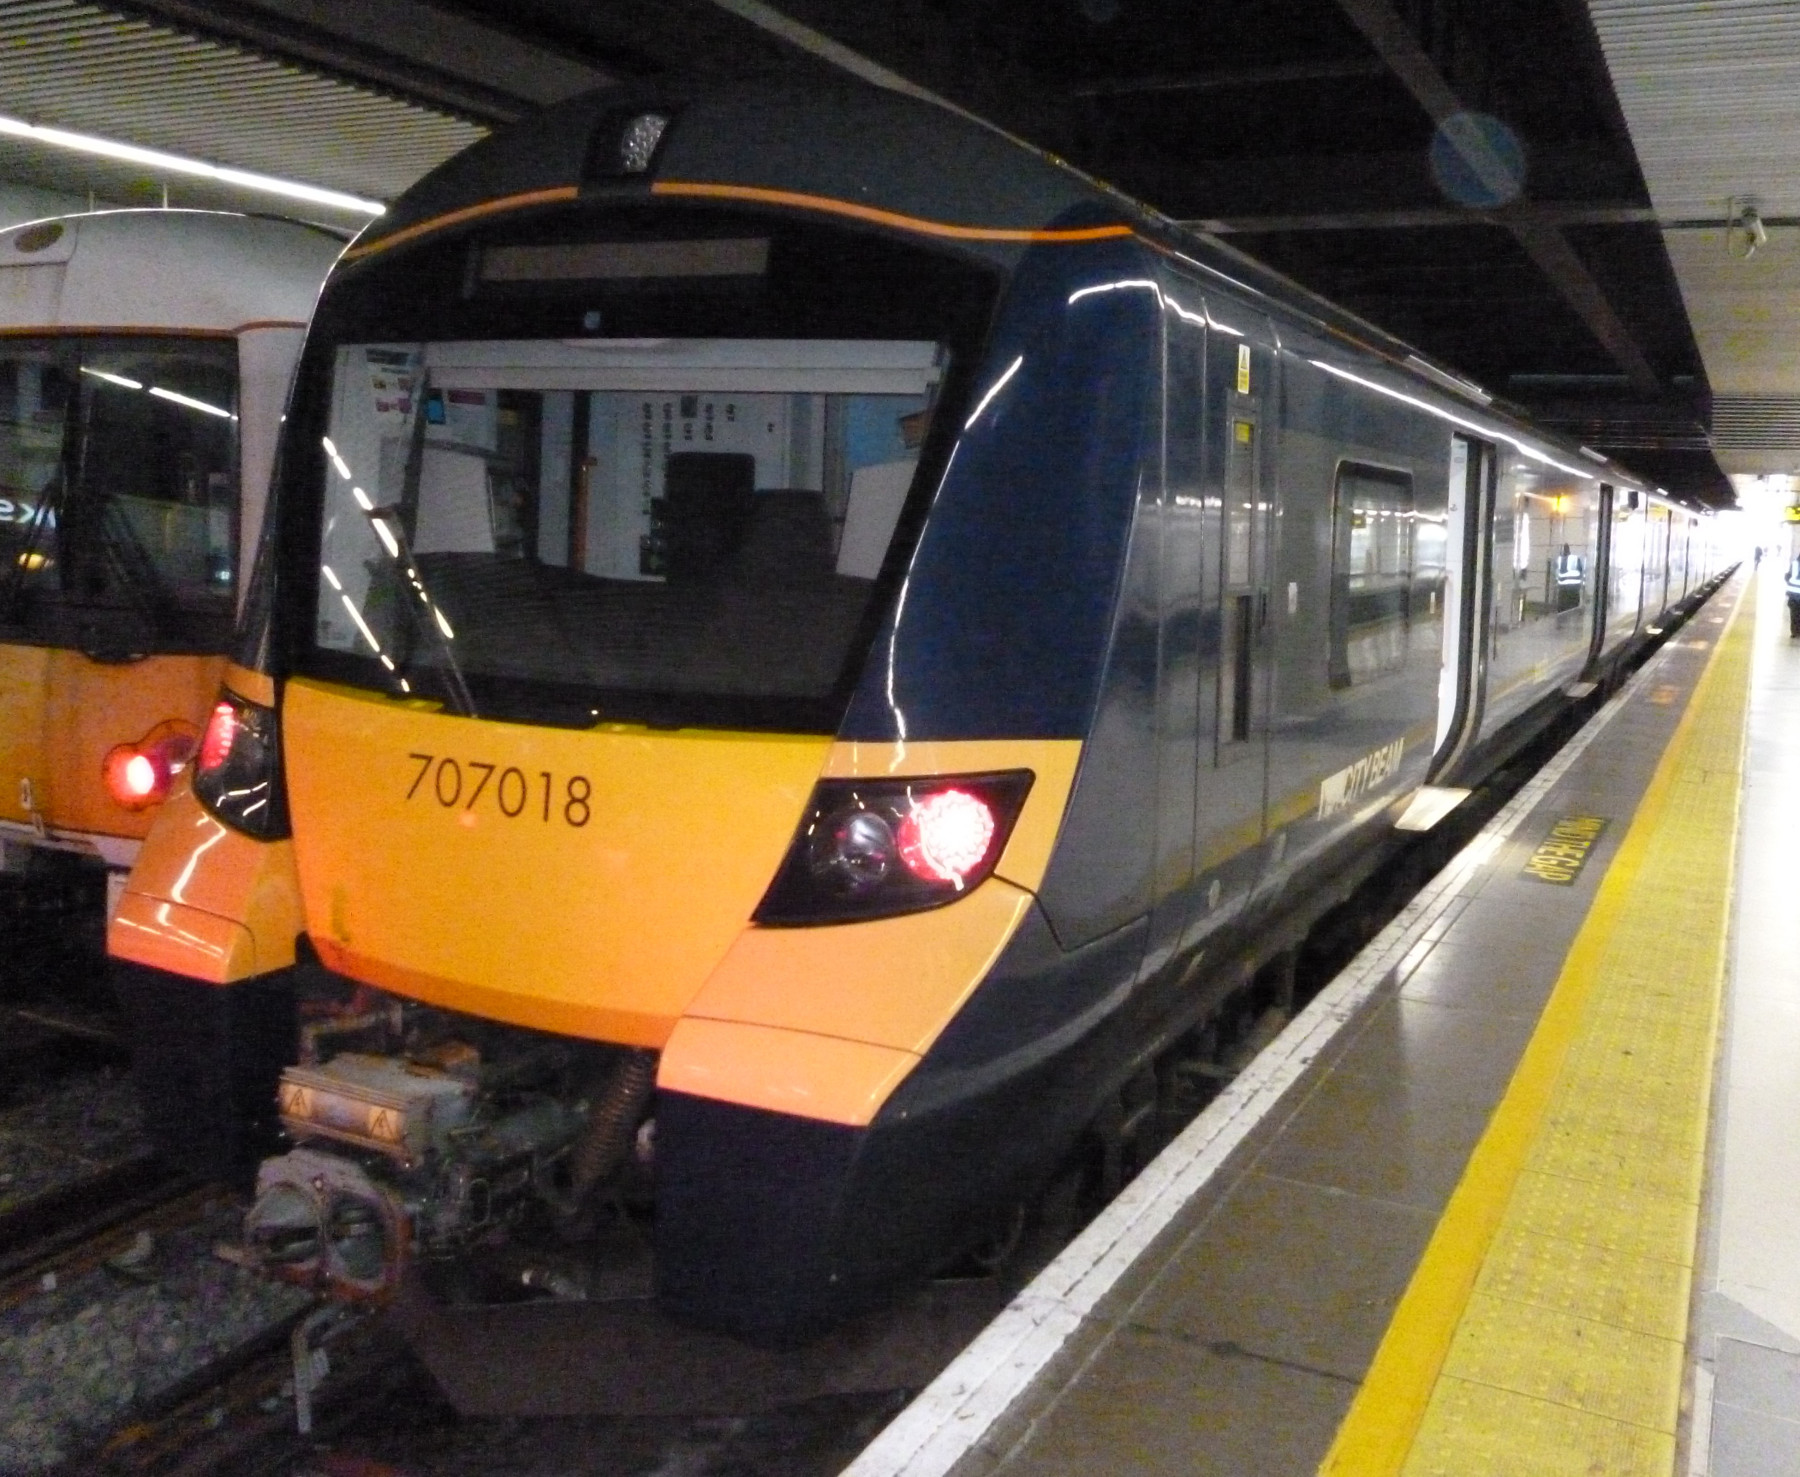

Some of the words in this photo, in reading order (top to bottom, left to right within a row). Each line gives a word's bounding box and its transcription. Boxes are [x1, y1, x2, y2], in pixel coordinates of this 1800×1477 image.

[406, 753, 591, 828] 707018
[1537, 841, 1591, 858] THE
[1523, 855, 1580, 880] GAP
